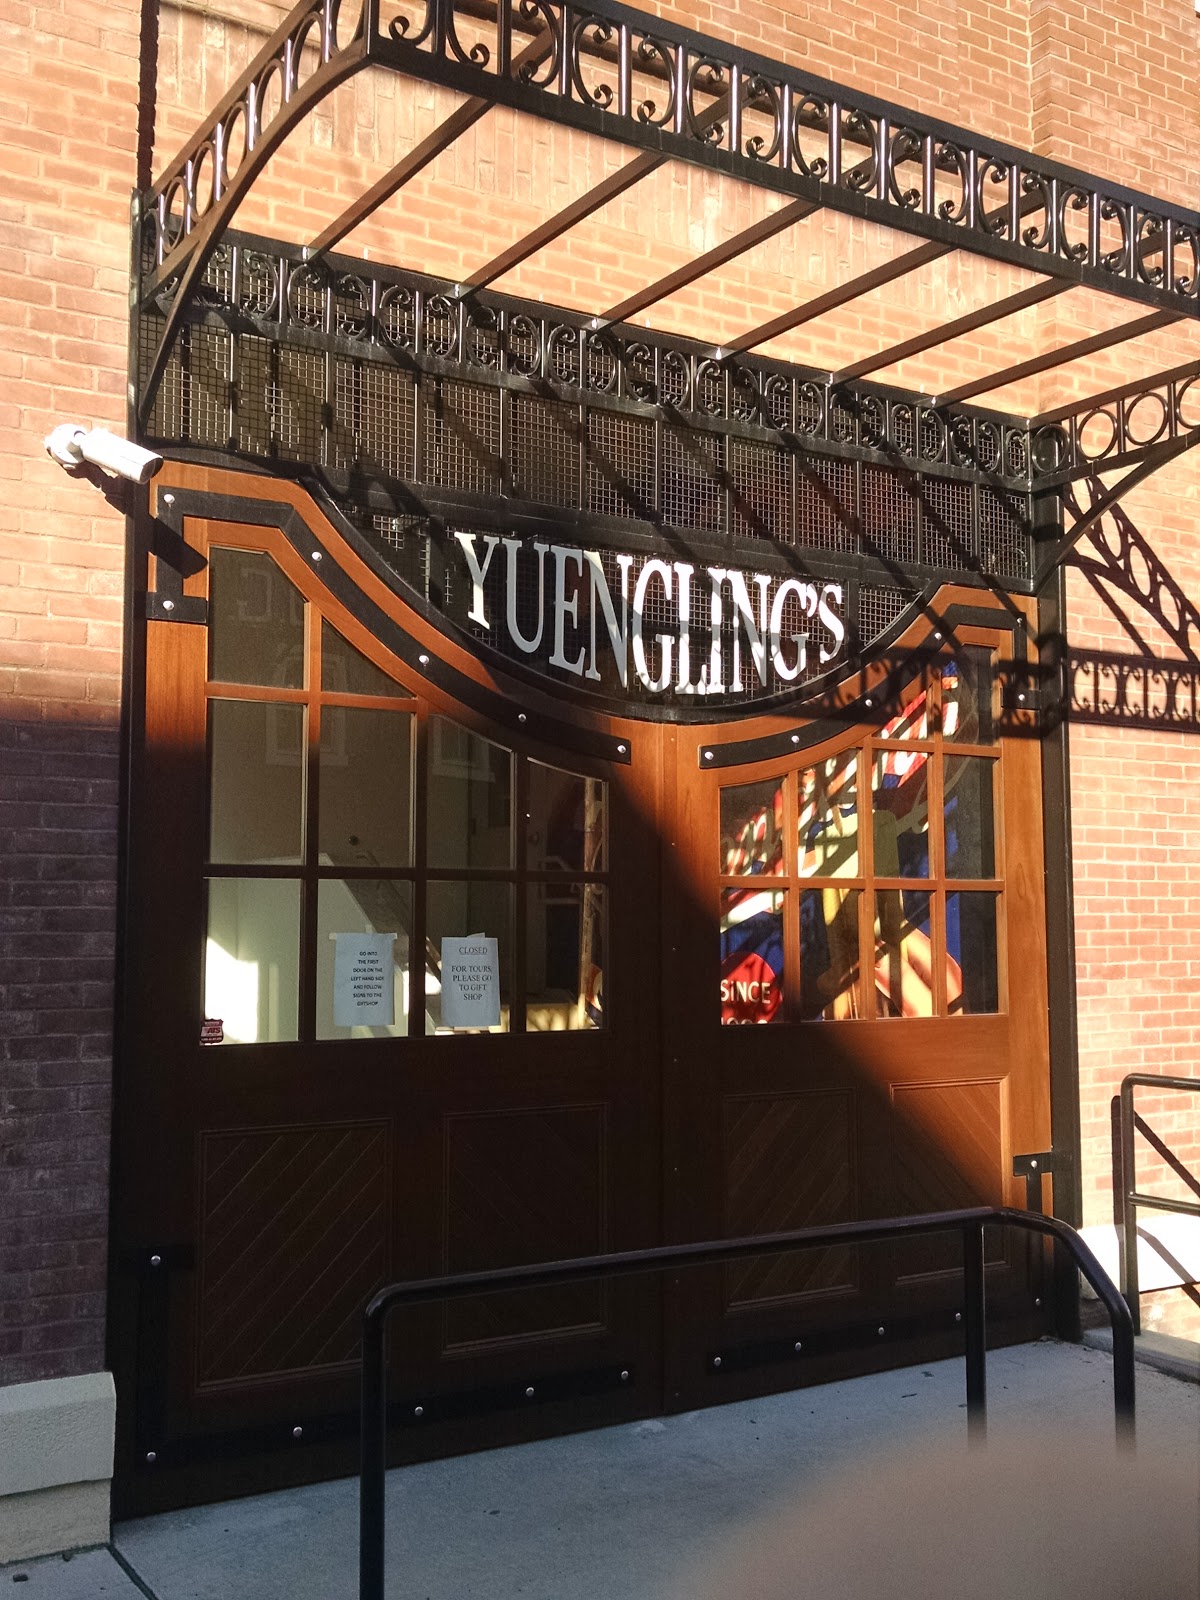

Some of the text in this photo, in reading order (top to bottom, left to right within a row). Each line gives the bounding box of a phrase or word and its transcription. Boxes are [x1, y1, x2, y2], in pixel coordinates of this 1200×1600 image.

[454, 531, 845, 696] YUENGLING'S
[458, 946, 488, 954] CLOSED
[452, 974, 481, 982] PLEASE
[463, 993, 483, 1001] SHOP
